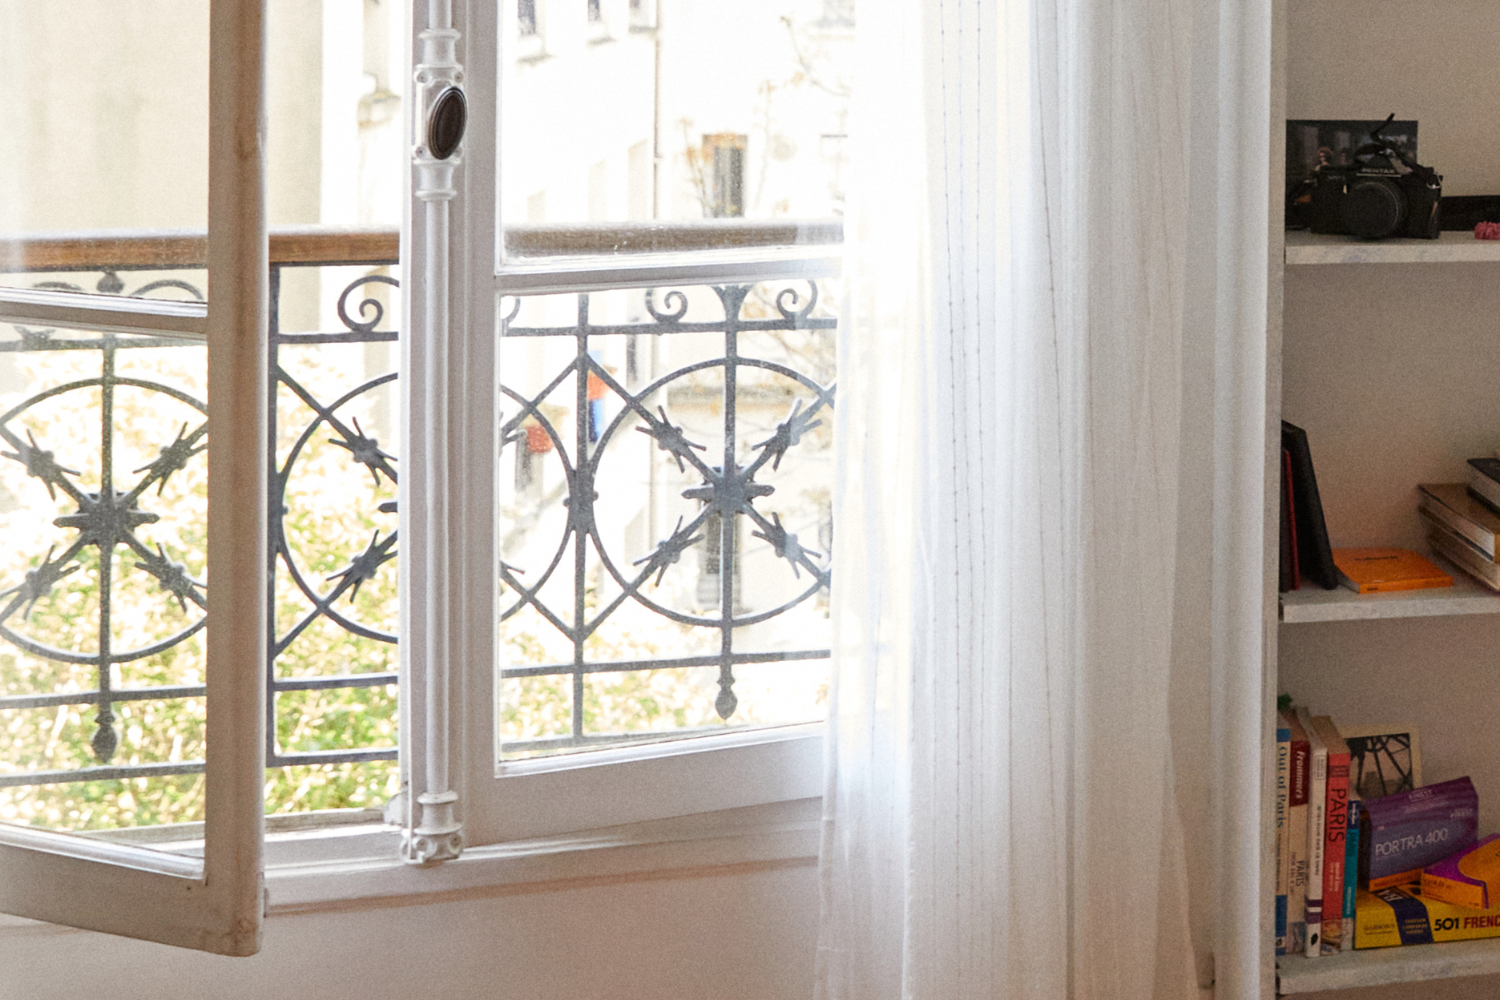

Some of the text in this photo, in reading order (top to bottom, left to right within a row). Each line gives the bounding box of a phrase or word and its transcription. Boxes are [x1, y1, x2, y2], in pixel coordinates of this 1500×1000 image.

[1278, 746, 1287, 770] Out
[1278, 775, 1286, 789] of
[1277, 794, 1287, 828] Paris
[1328, 788, 1347, 843] PARIS
[1375, 833, 1424, 857] PORTRA
[1424, 826, 1449, 845] 400
[1433, 917, 1460, 932] 501
